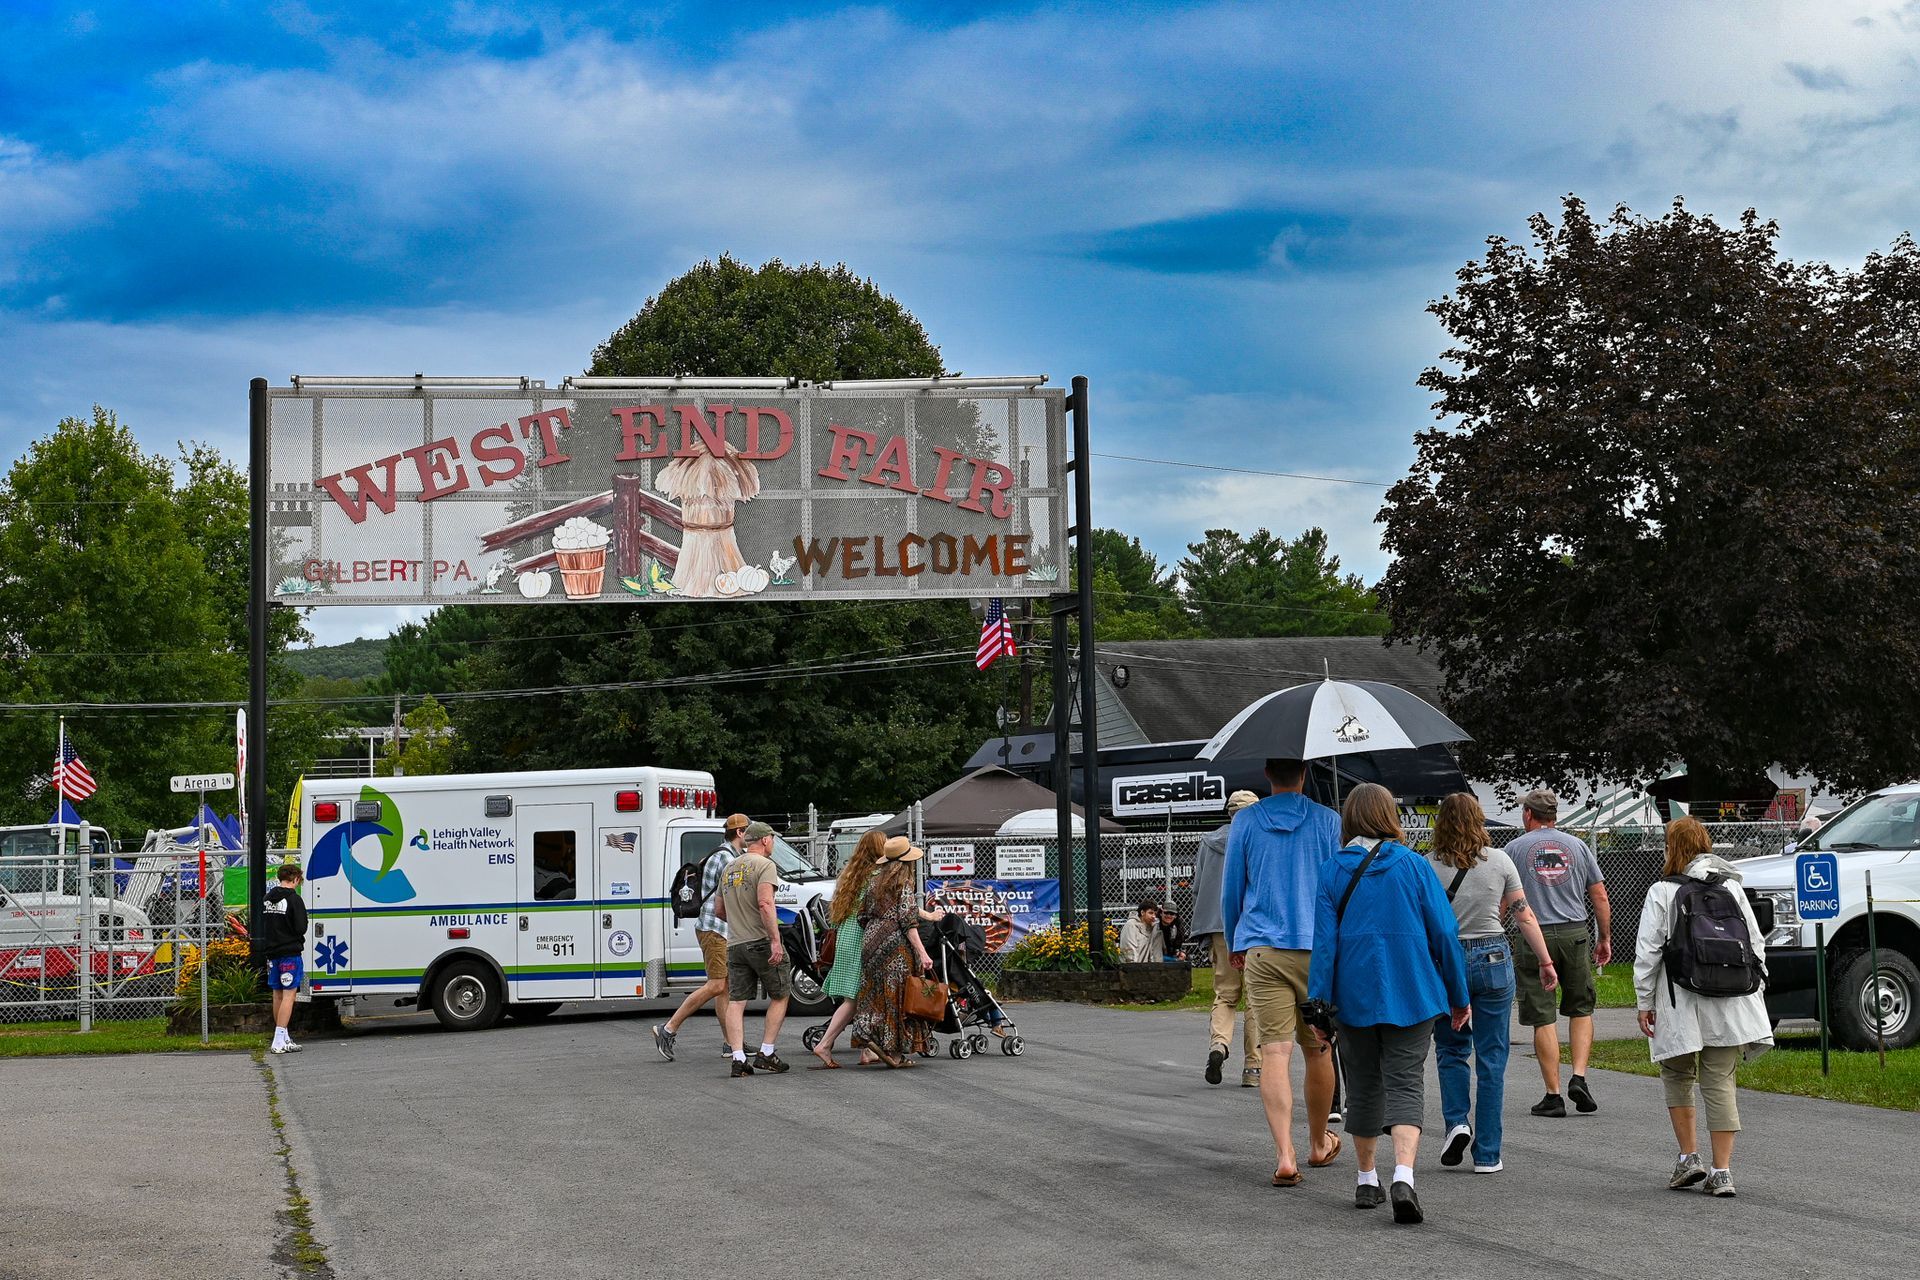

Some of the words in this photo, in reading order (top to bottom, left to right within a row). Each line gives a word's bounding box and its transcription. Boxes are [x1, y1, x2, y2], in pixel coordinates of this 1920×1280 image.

[315, 407, 571, 524] WEST
[611, 404, 795, 461] END
[817, 423, 1015, 519] FAIR
[792, 532, 1033, 579] WELCOME
[304, 559, 422, 583] GILBERT
[173, 780, 179, 788] N
[184, 778, 217, 789] Arena
[222, 777, 231, 785] LN
[1119, 775, 1223, 805] casella
[1400, 814, 1428, 828] SLOW
[433, 827, 469, 840] Lehigh
[469, 827, 502, 839] Valley
[433, 839, 467, 850] Health
[468, 838, 515, 849] Network
[488, 853, 515, 865] EMS
[933, 888, 995, 905] Putting
[997, 890, 1034, 904] your
[934, 905, 968, 913] own
[972, 903, 1007, 917] spin
[1009, 904, 1030, 913] on
[1800, 899, 1838, 912] PARKING
[430, 913, 508, 927] AMBULANCE
[965, 914, 996, 926] fun.
[536, 935, 574, 943] EMERGENCY
[553, 943, 575, 957] 911
